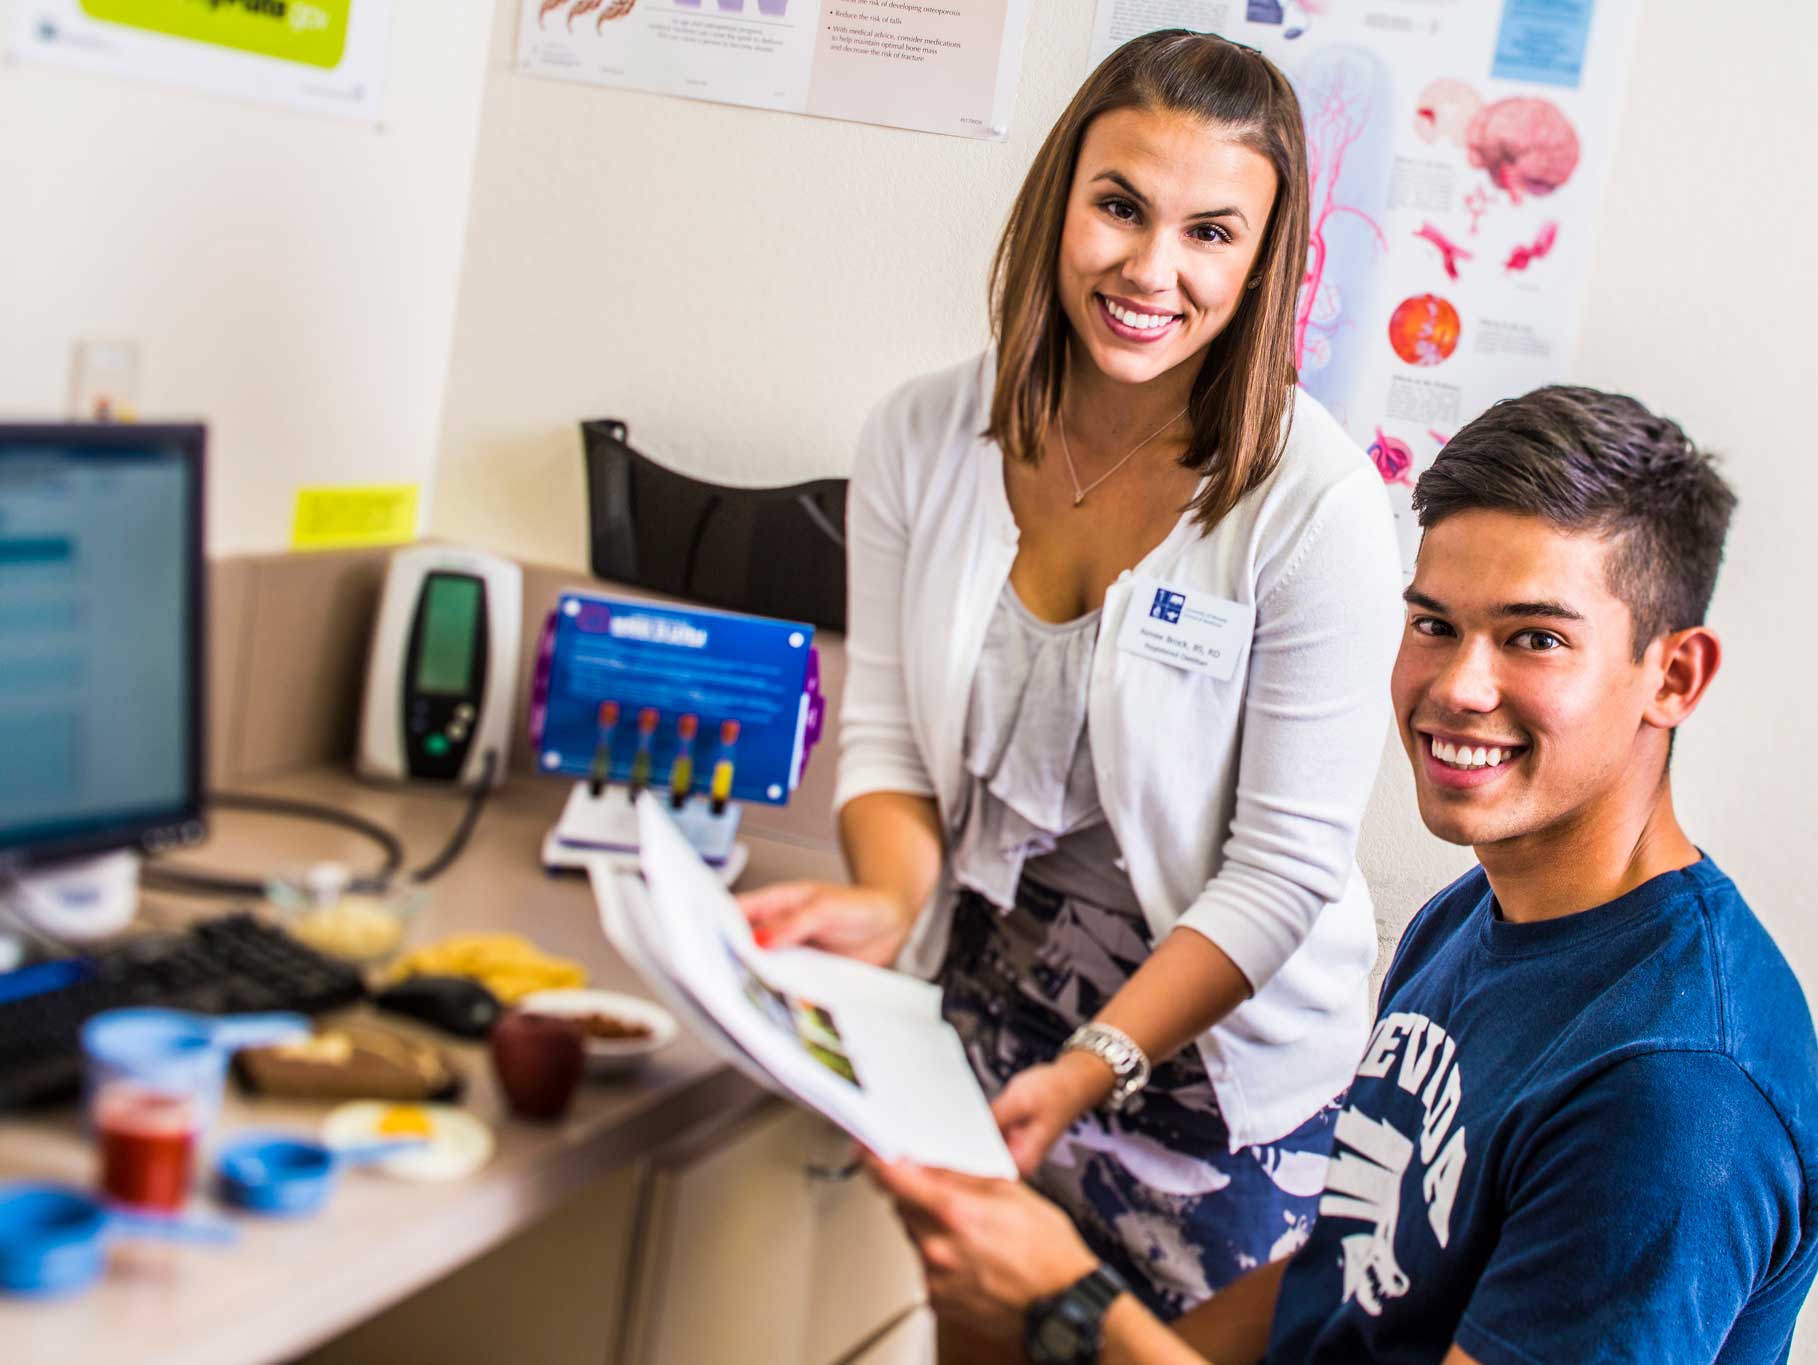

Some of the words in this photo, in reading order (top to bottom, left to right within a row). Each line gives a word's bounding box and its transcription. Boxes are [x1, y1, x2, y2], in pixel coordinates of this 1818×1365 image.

[835, 10, 857, 19] Reduce
[889, 1, 922, 13] developing
[833, 25, 847, 33] With
[849, 28, 873, 38] medical
[897, 35, 923, 43] consider
[924, 38, 961, 49] medications
[839, 34, 852, 44] help
[854, 37, 880, 47] maintain
[881, 41, 904, 51] optimal
[905, 44, 921, 52] bone
[922, 47, 938, 55] mass
[843, 44, 869, 54] decrease
[881, 50, 891, 58] risk
[901, 52, 924, 62] fracture
